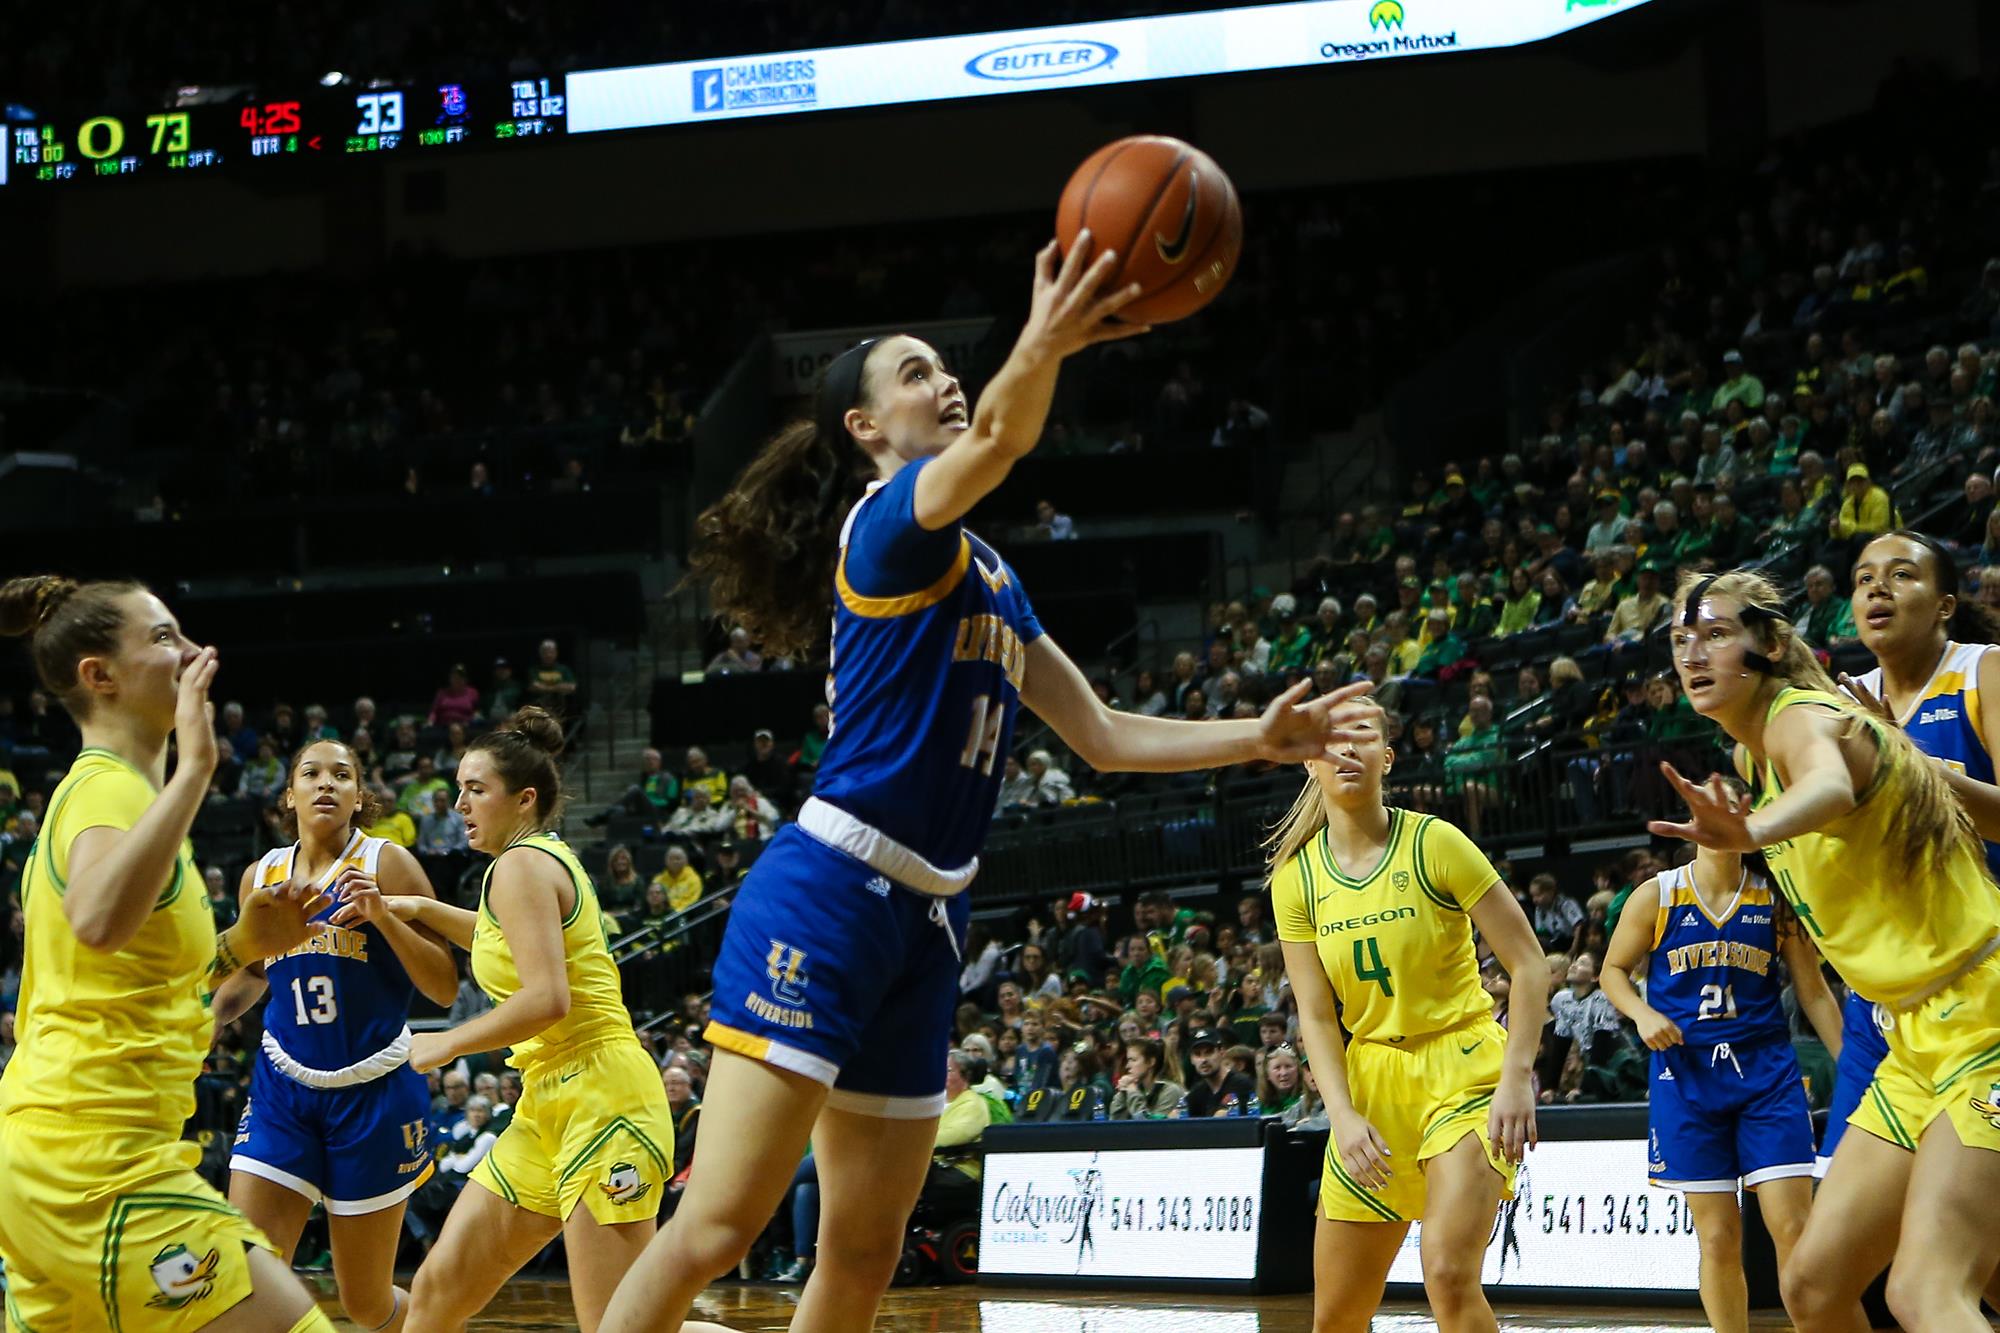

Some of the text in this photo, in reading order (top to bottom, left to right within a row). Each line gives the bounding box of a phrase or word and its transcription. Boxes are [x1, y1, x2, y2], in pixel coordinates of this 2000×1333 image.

[992, 48, 1092, 71] BUTLER
[1321, 31, 1456, 59] Oregon Mutual
[511, 78, 549, 99] TOL 1
[726, 60, 815, 87] CHAMBERS
[513, 96, 564, 117] FLS 02
[727, 83, 816, 106] CONSTRUCTION
[241, 101, 300, 136] 4:25
[357, 92, 403, 134] 33
[15, 128, 38, 146] TOL
[147, 112, 190, 154] 73
[16, 147, 38, 164] FLS
[1320, 906, 1416, 937] OREGON
[1353, 937, 1394, 997] 4
[1667, 940, 1772, 977] RIVERSIDE
[290, 975, 338, 1025] 13
[744, 991, 815, 1029] RIVERSIDE
[1697, 984, 1738, 1020] 21
[992, 1182, 1253, 1244] Oakway 541.343.3088
[1542, 1195, 1695, 1235] 541.343.30
